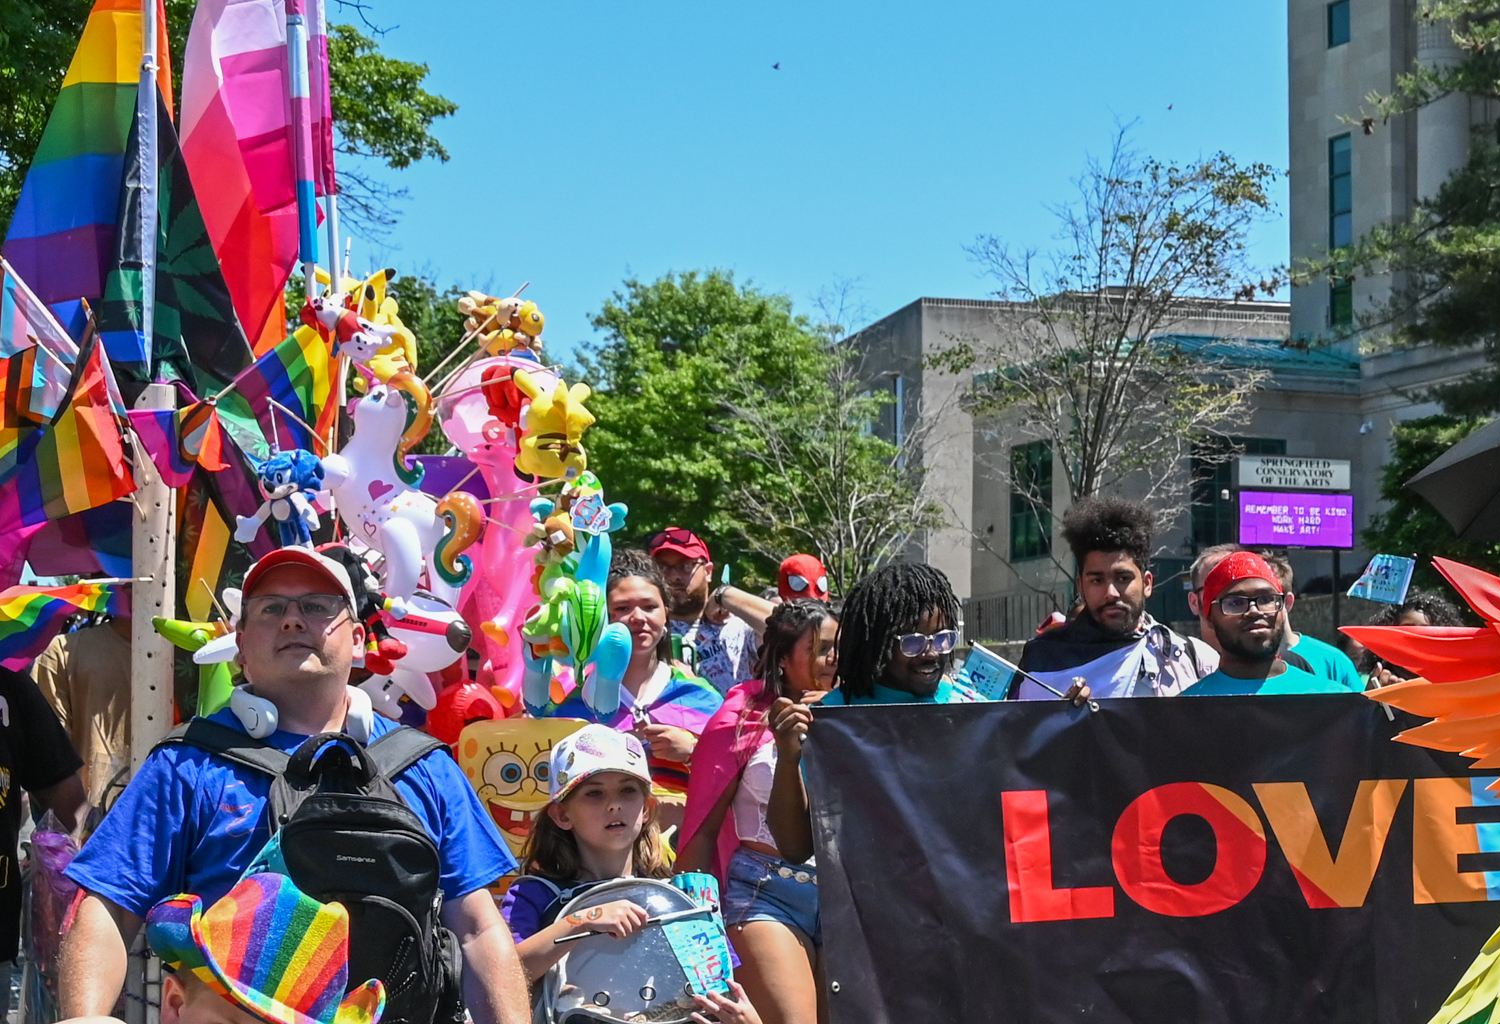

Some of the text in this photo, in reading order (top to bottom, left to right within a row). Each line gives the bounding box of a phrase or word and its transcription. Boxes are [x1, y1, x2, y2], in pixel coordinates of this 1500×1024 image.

[1260, 458, 1331, 469] SPRINGFIELD
[1255, 467, 1335, 479] CONSERVATORY
[1260, 476, 1331, 487] OF THE ARTS
[1245, 504, 1289, 515] REMEMBER
[1293, 506, 1304, 515] TO
[1309, 507, 1321, 516] BE
[1272, 515, 1321, 525] WORK HARD
[1273, 524, 1295, 534] MAKE
[336, 854, 376, 863] Samsonite
